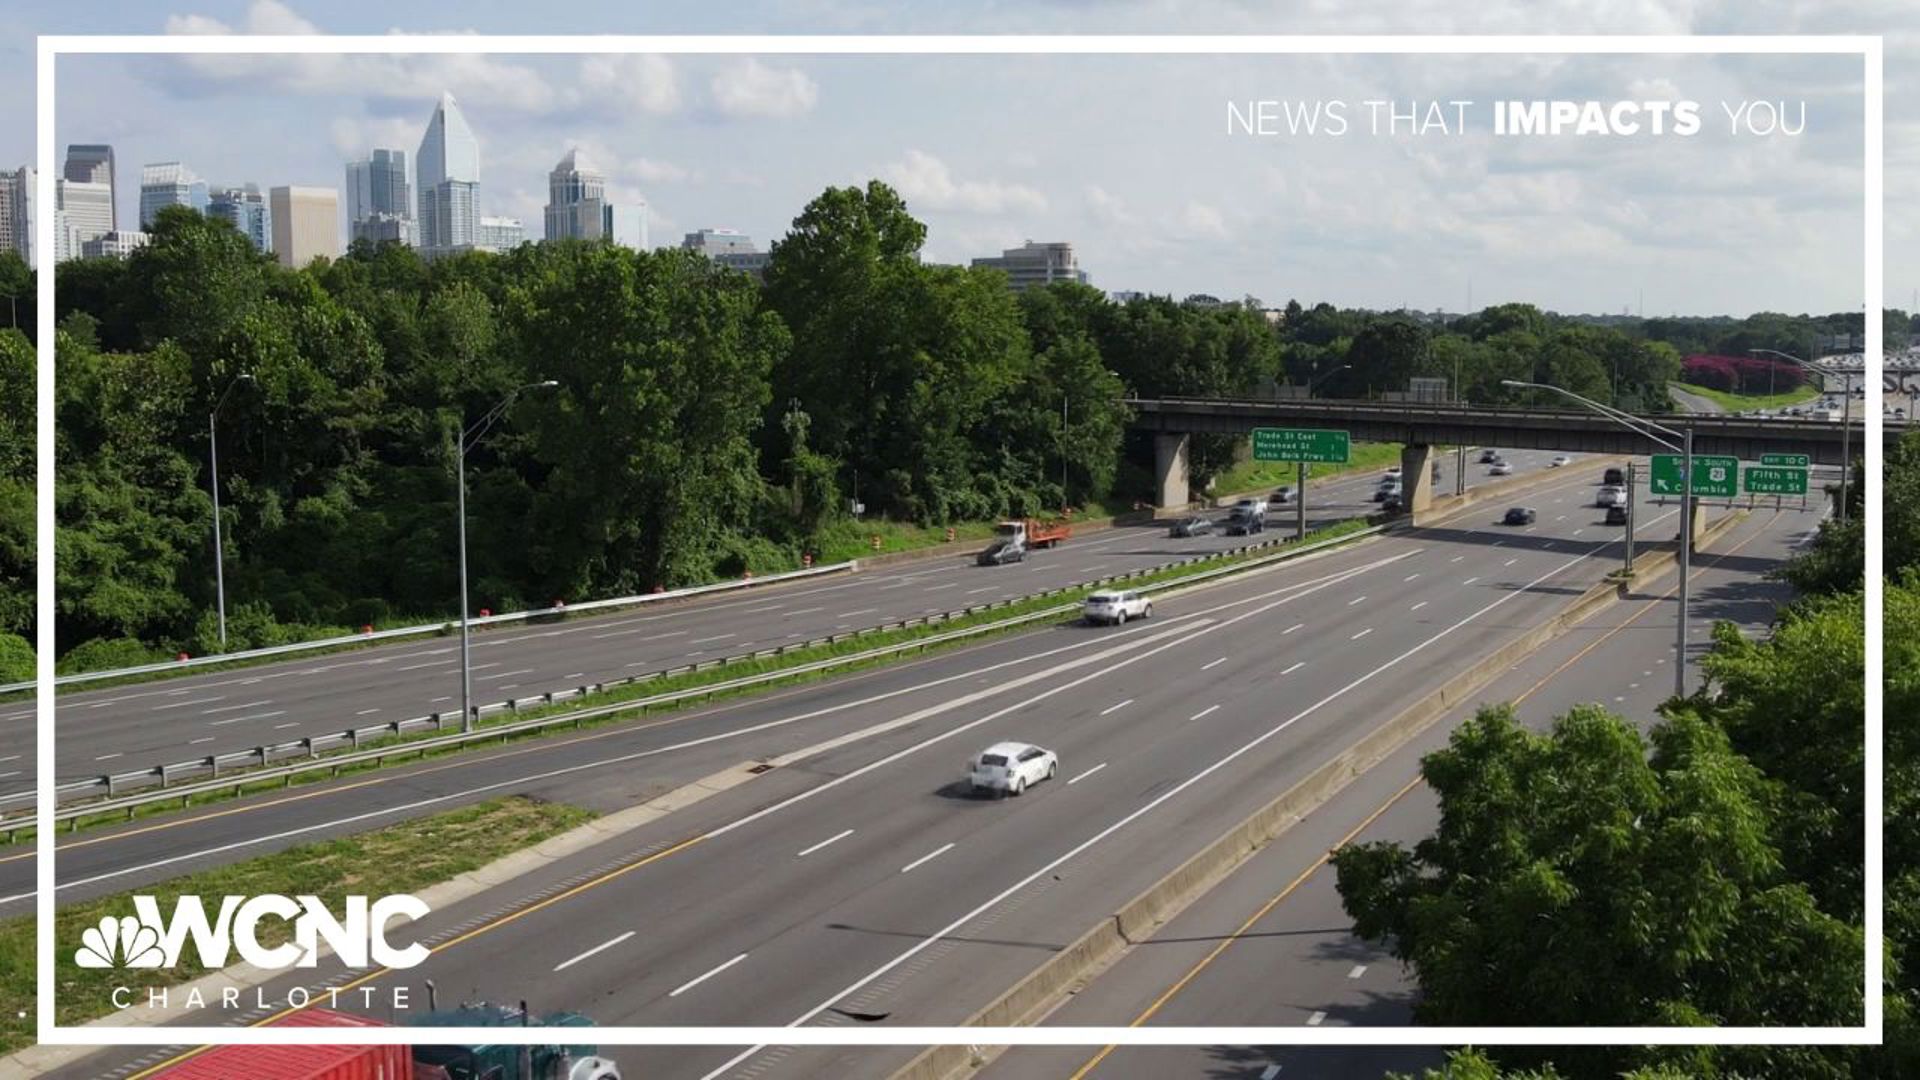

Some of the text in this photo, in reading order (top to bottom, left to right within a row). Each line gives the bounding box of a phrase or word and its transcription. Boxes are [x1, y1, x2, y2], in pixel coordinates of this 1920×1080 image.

[1257, 431, 1281, 440] Trade
[1785, 457, 1796, 465] 10
[1752, 471, 1800, 480] Fifth St
[1674, 483, 1727, 494] Cumbia
[1751, 481, 1800, 492] Trade St
